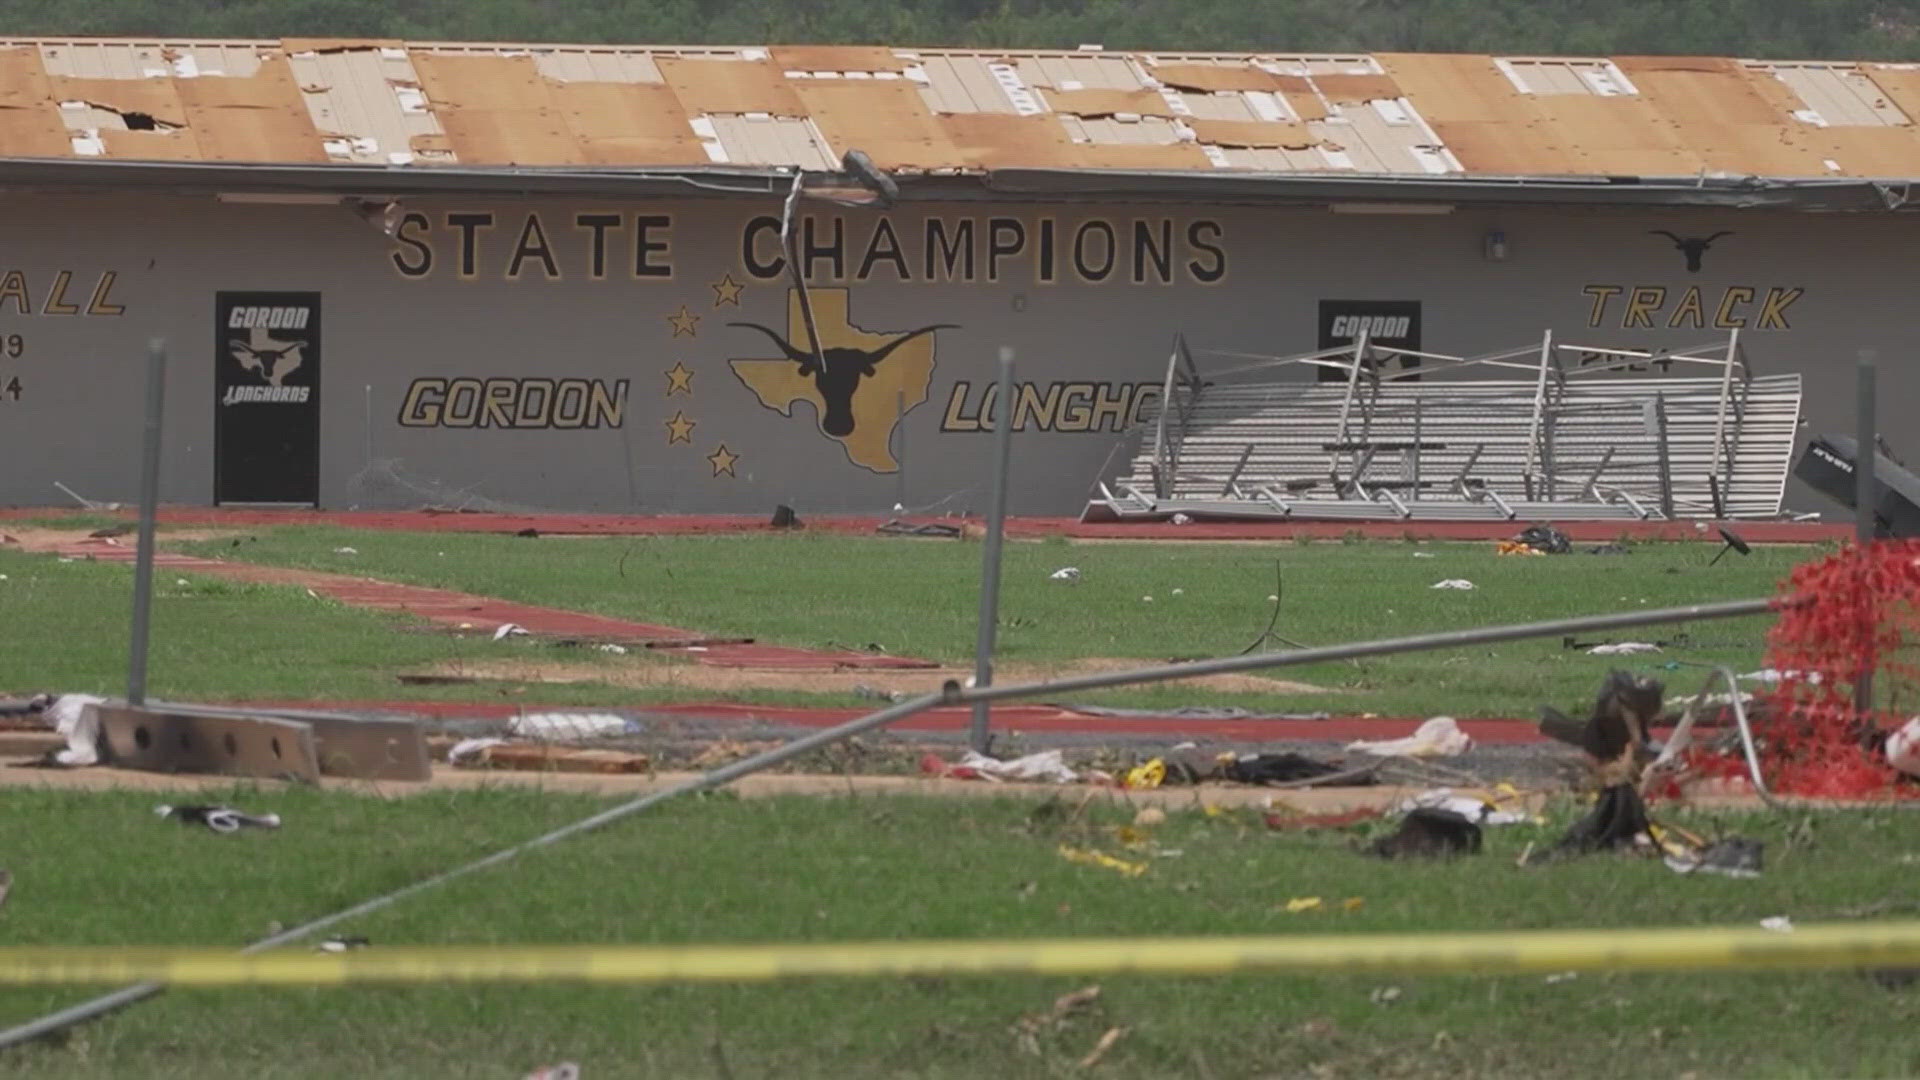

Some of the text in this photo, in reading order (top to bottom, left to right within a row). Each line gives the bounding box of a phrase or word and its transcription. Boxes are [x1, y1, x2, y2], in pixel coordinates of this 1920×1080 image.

[391, 212, 1226, 283] STATE CHAMPIONS
[0, 270, 126, 315] ALL
[1582, 286, 1805, 329] TRACK
[228, 306, 310, 329] GORDON
[1330, 315, 1411, 338] GORDON
[0, 334, 24, 358] 9
[222, 385, 310, 406] LONGHORNS
[398, 377, 1213, 433] GORDON LONGHO
